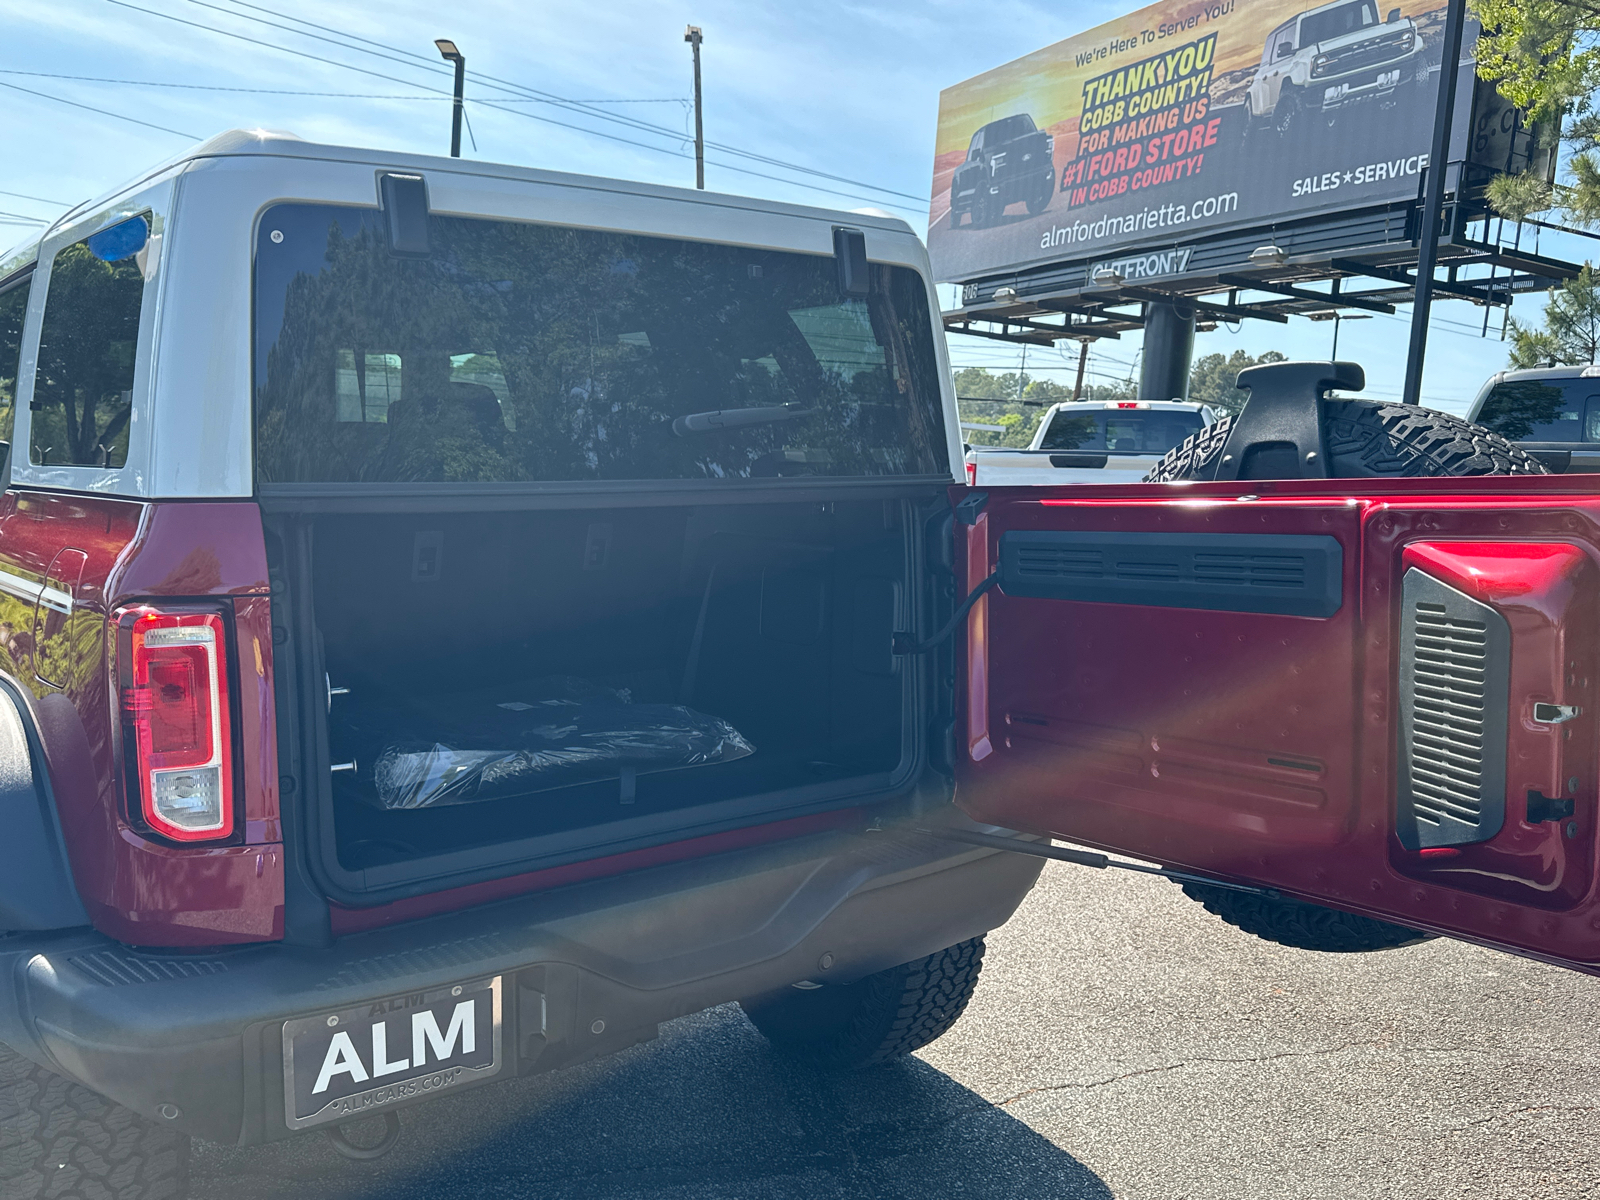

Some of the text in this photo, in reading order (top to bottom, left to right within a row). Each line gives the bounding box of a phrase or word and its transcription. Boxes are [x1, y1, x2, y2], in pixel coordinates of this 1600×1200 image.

[1075, 0, 1235, 68] We're Here To Server You!
[1081, 70, 1210, 133] COBB COUNTY!
[1085, 37, 1214, 110] THANK YOU
[1063, 117, 1222, 188] #1 FORD STORE
[1079, 98, 1208, 156] FOR MAKING US
[1070, 154, 1204, 207] IN COBB COUNTY!
[1291, 153, 1429, 197] SALES SERVICE
[1040, 192, 1238, 249] almfordmarietta.com
[368, 993, 424, 1018] ALM
[312, 999, 476, 1095] ALM
[340, 1070, 456, 1115] ALMCARS.COM
